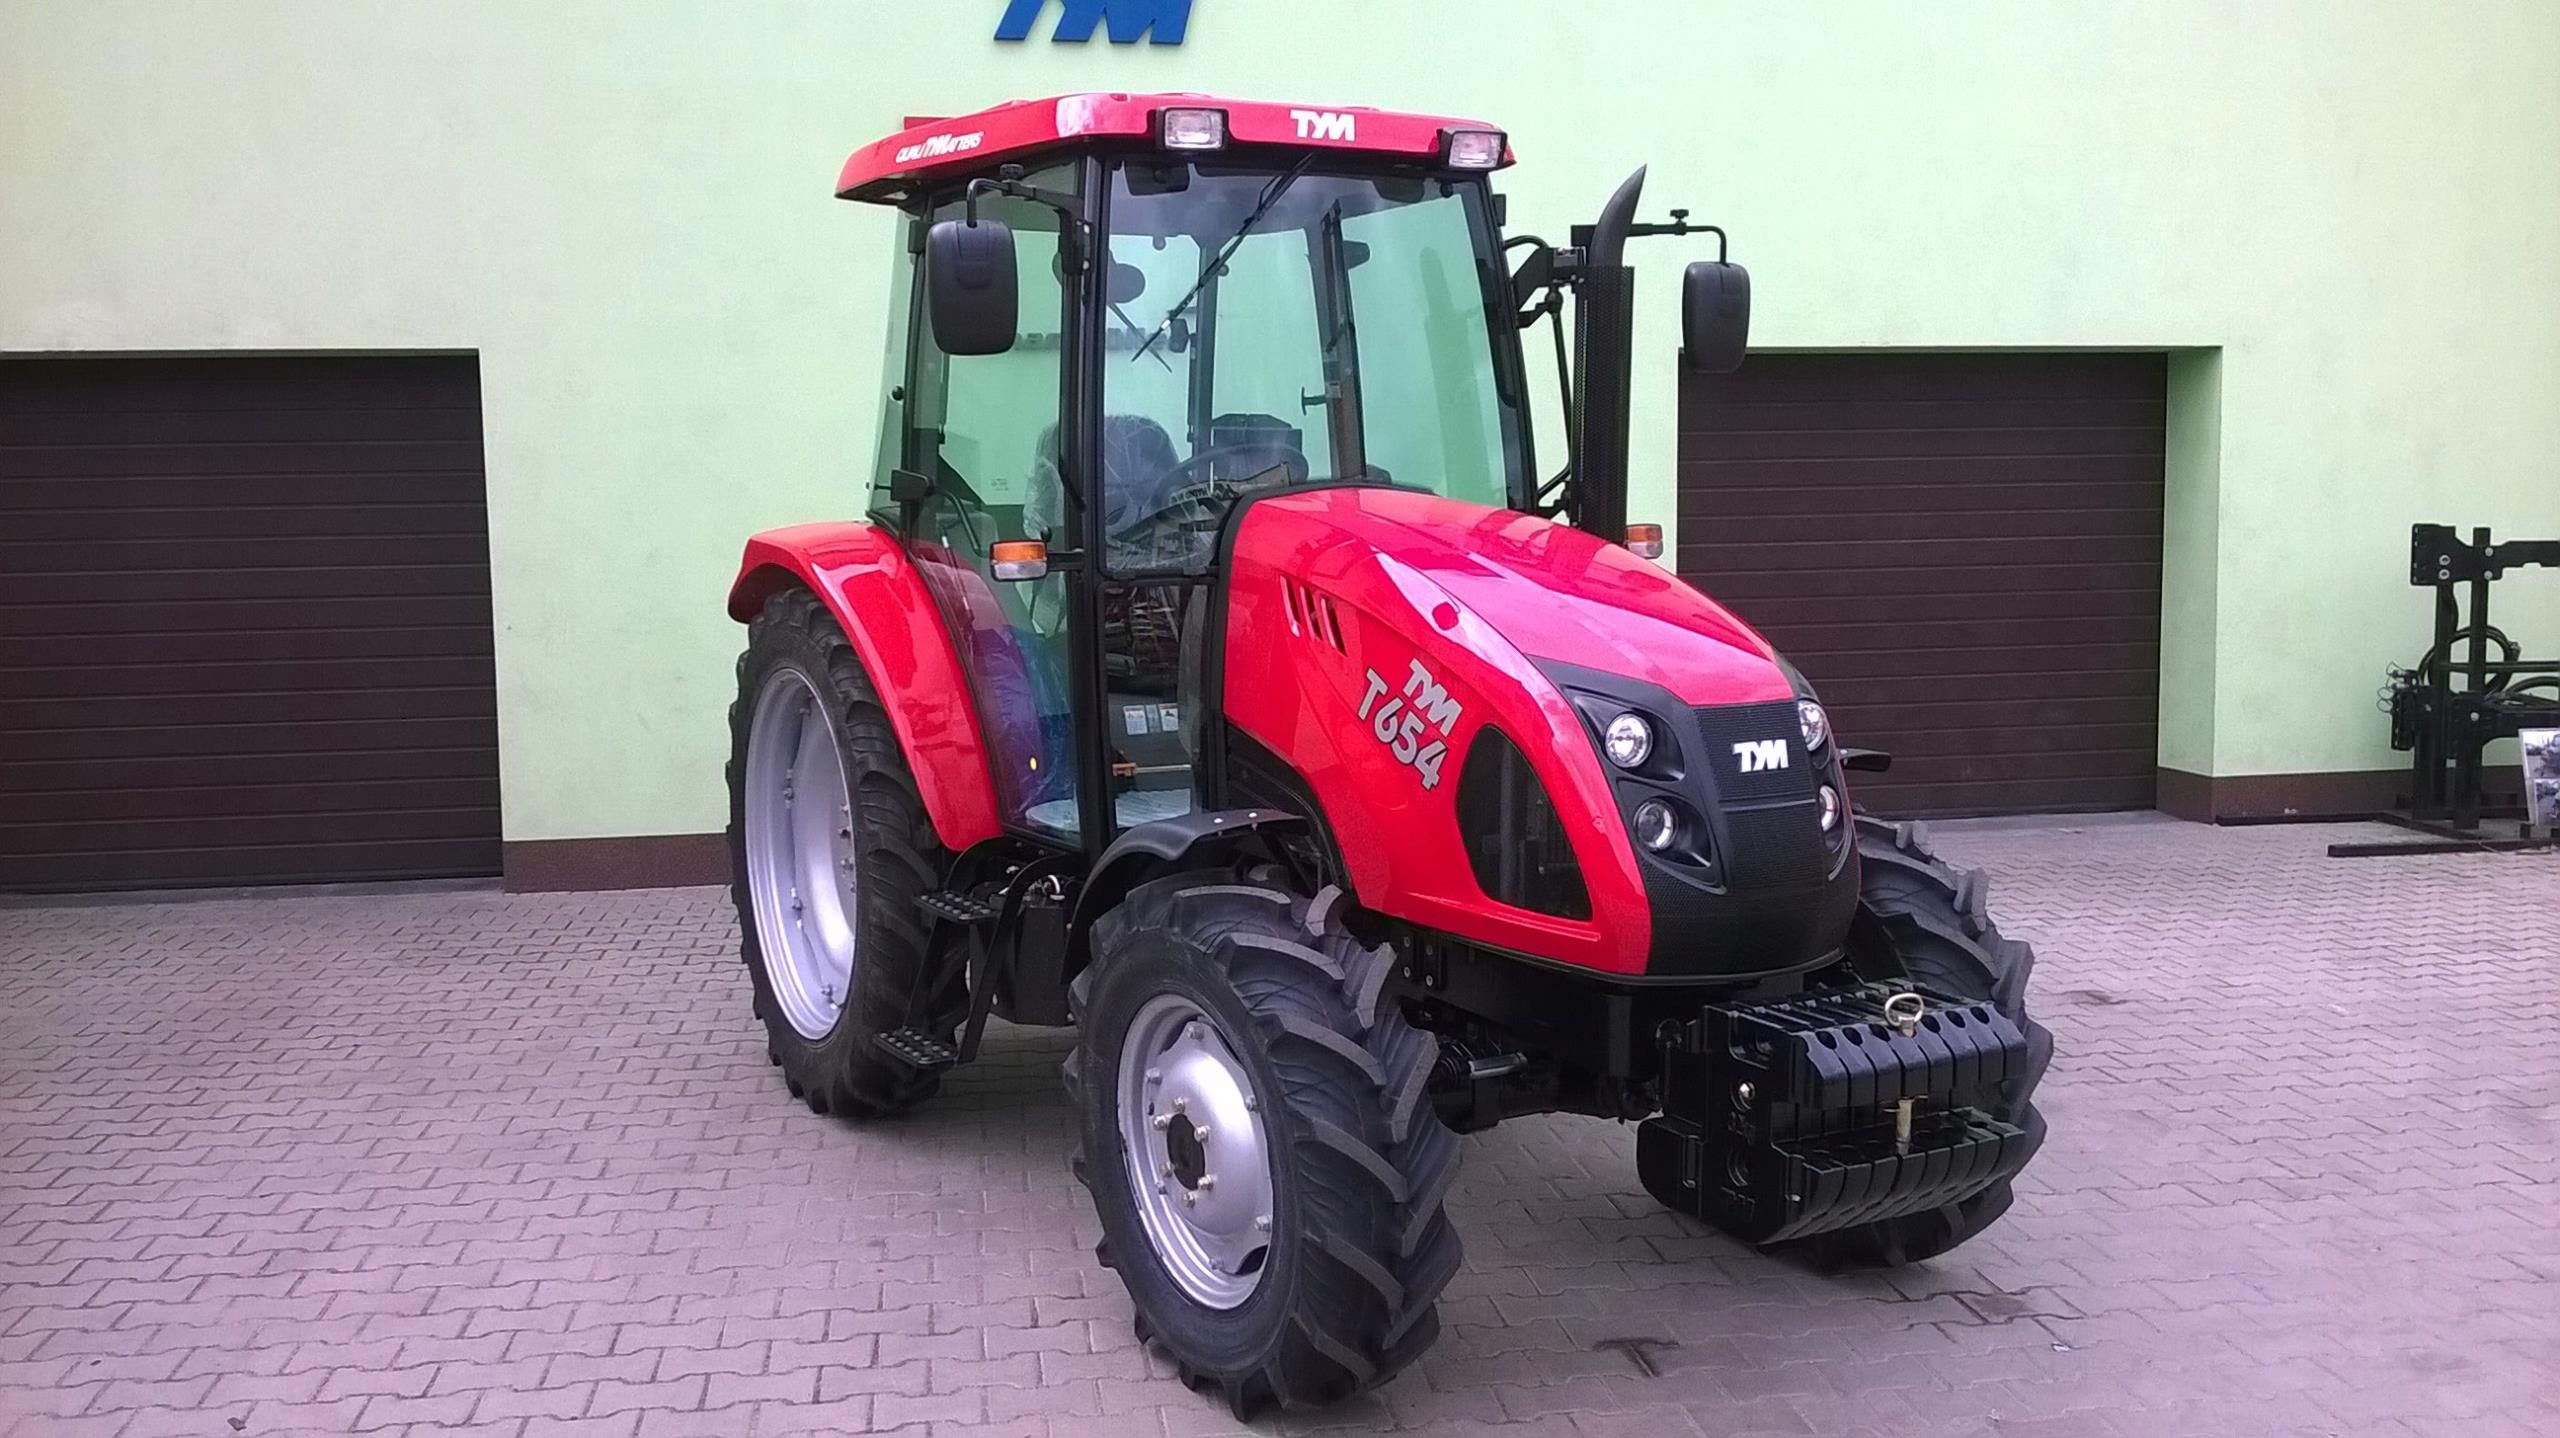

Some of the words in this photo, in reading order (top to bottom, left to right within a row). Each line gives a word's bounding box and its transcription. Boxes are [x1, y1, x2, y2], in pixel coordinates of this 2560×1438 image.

[1290, 109, 1355, 142] TYM
[1402, 658, 1463, 737] TYM
[1358, 667, 1448, 791] T654
[1732, 739, 1789, 773] TYM
